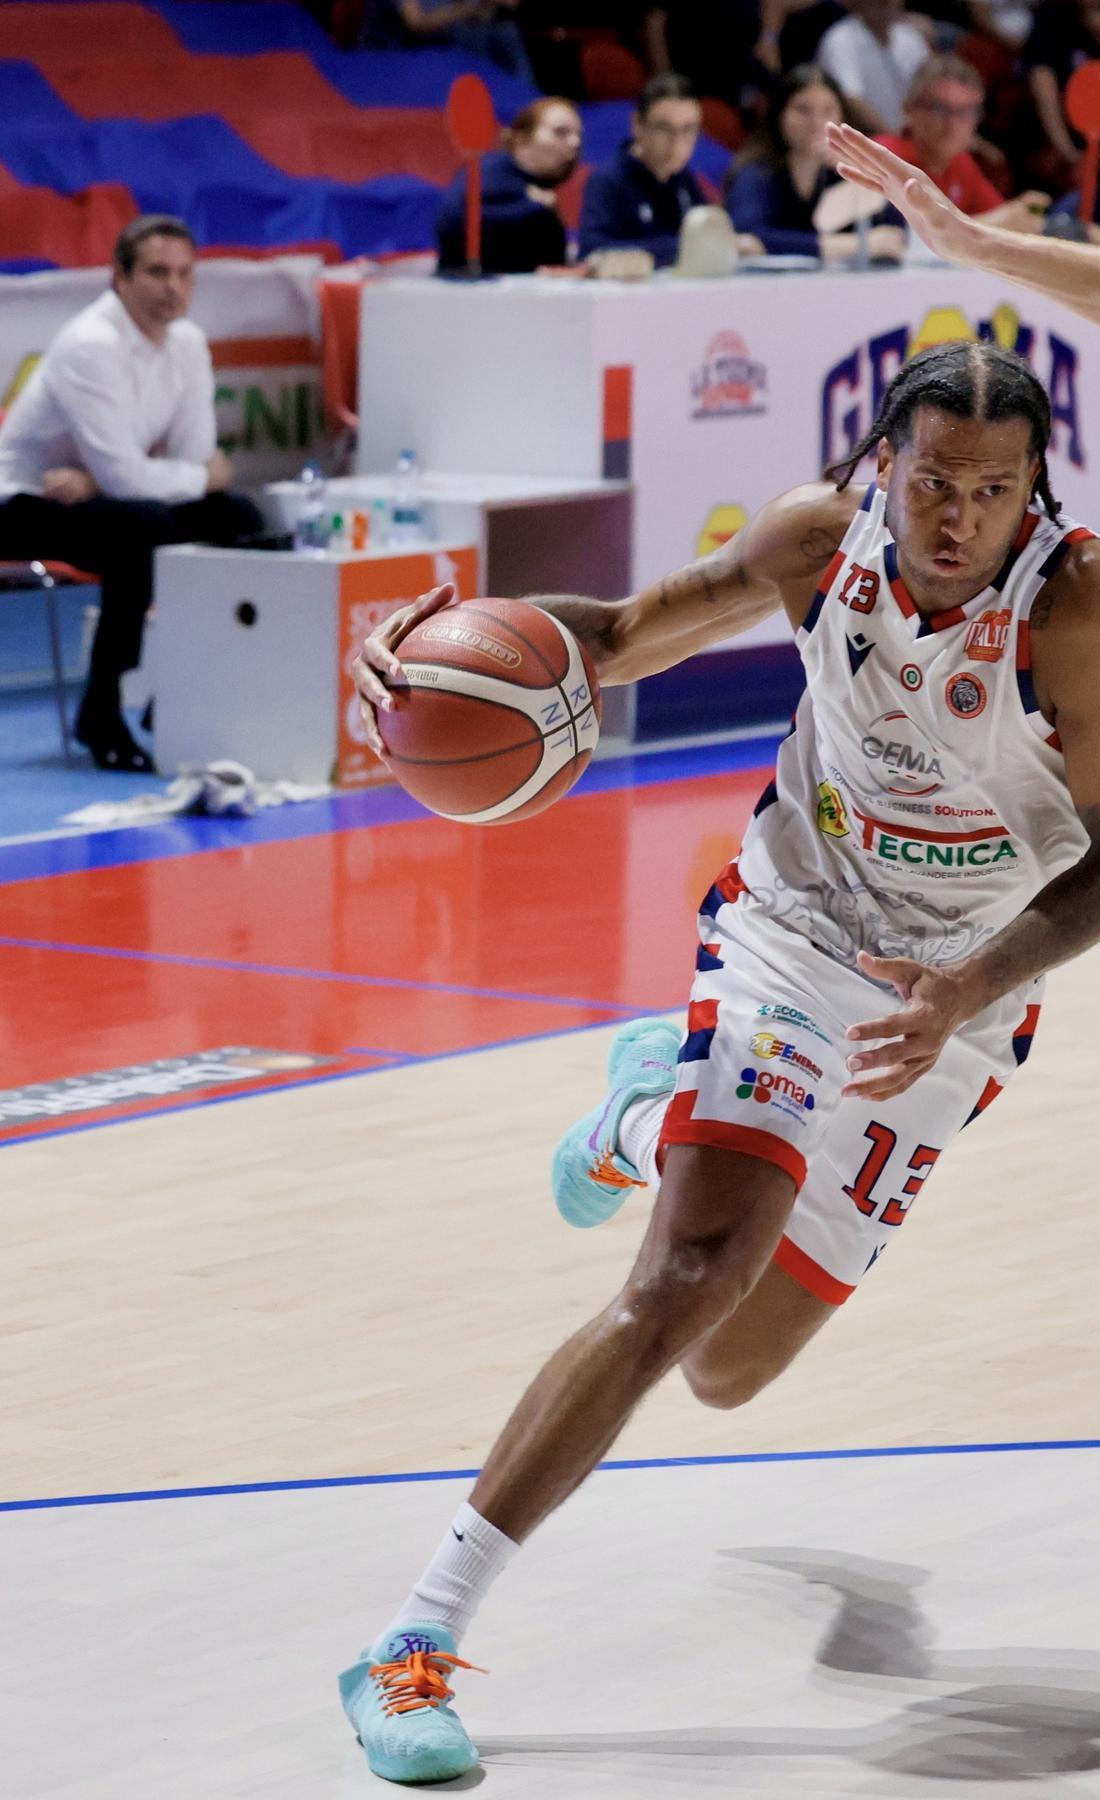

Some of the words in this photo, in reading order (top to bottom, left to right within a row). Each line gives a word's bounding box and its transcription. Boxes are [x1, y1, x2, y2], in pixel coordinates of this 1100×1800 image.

[838, 562, 881, 615] 13
[861, 736, 946, 780] GEMA
[852, 806, 1018, 867] TECNICA
[757, 1071, 806, 1105] oma
